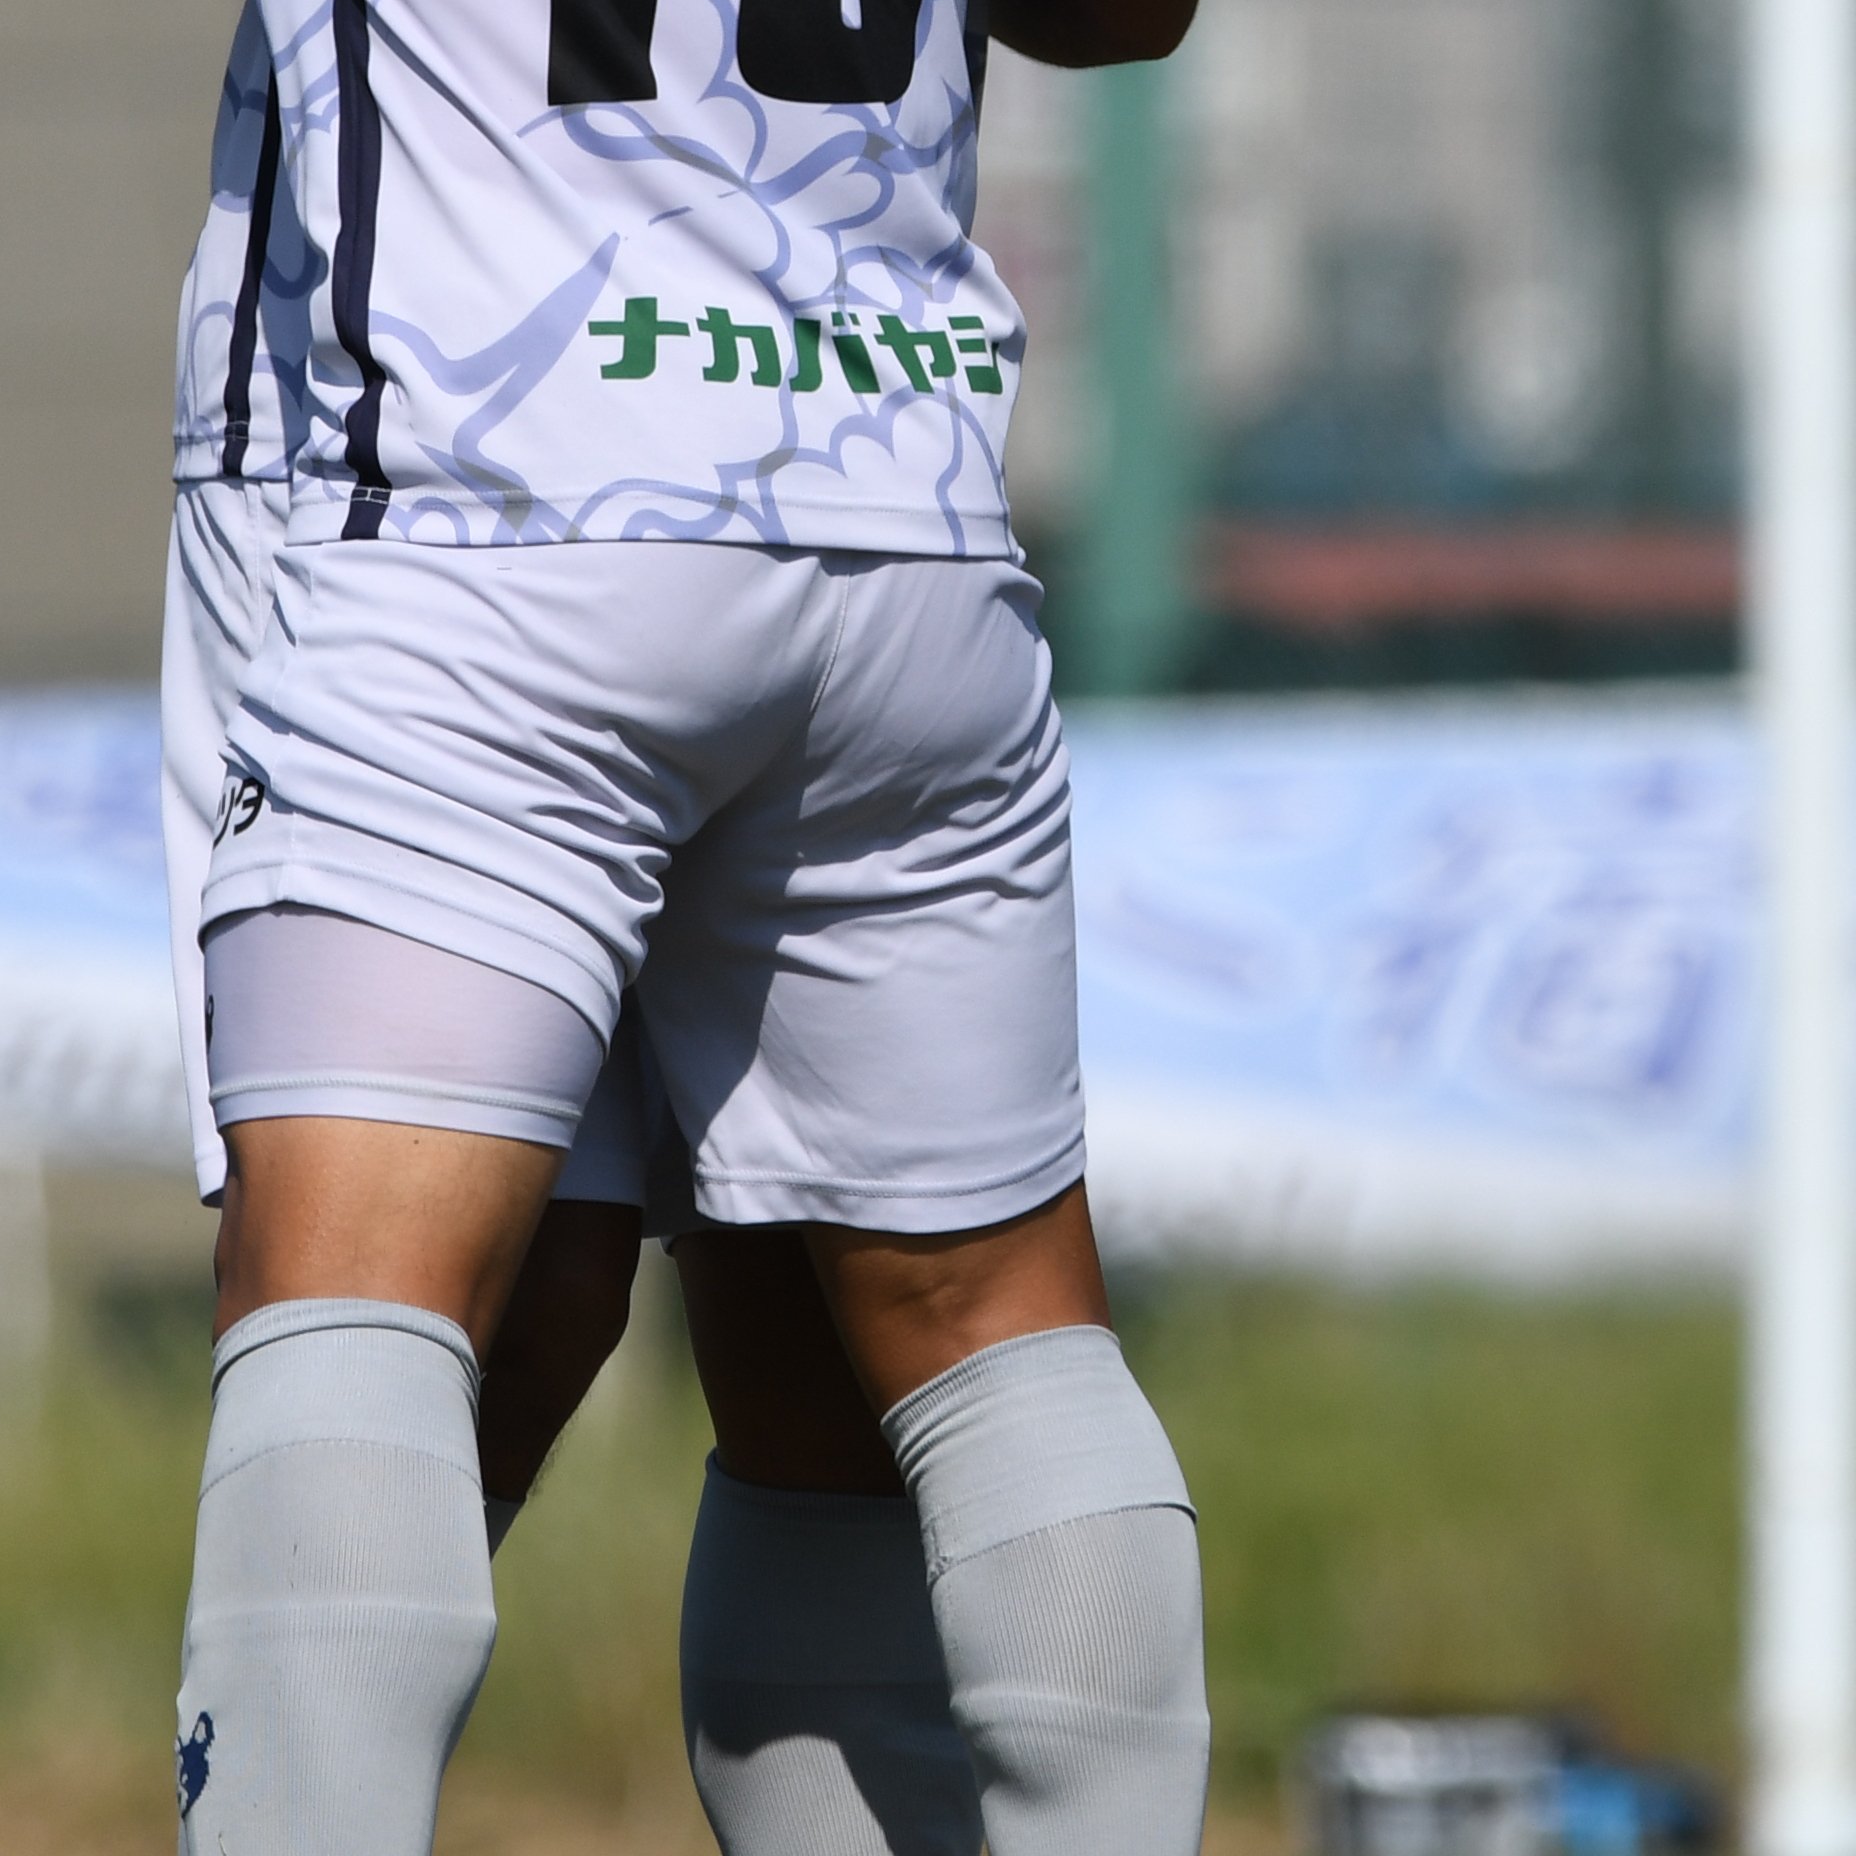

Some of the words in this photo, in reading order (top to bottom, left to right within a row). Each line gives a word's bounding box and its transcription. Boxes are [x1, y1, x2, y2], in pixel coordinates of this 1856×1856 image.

[587, 296, 1004, 396] ナカバヤシ
